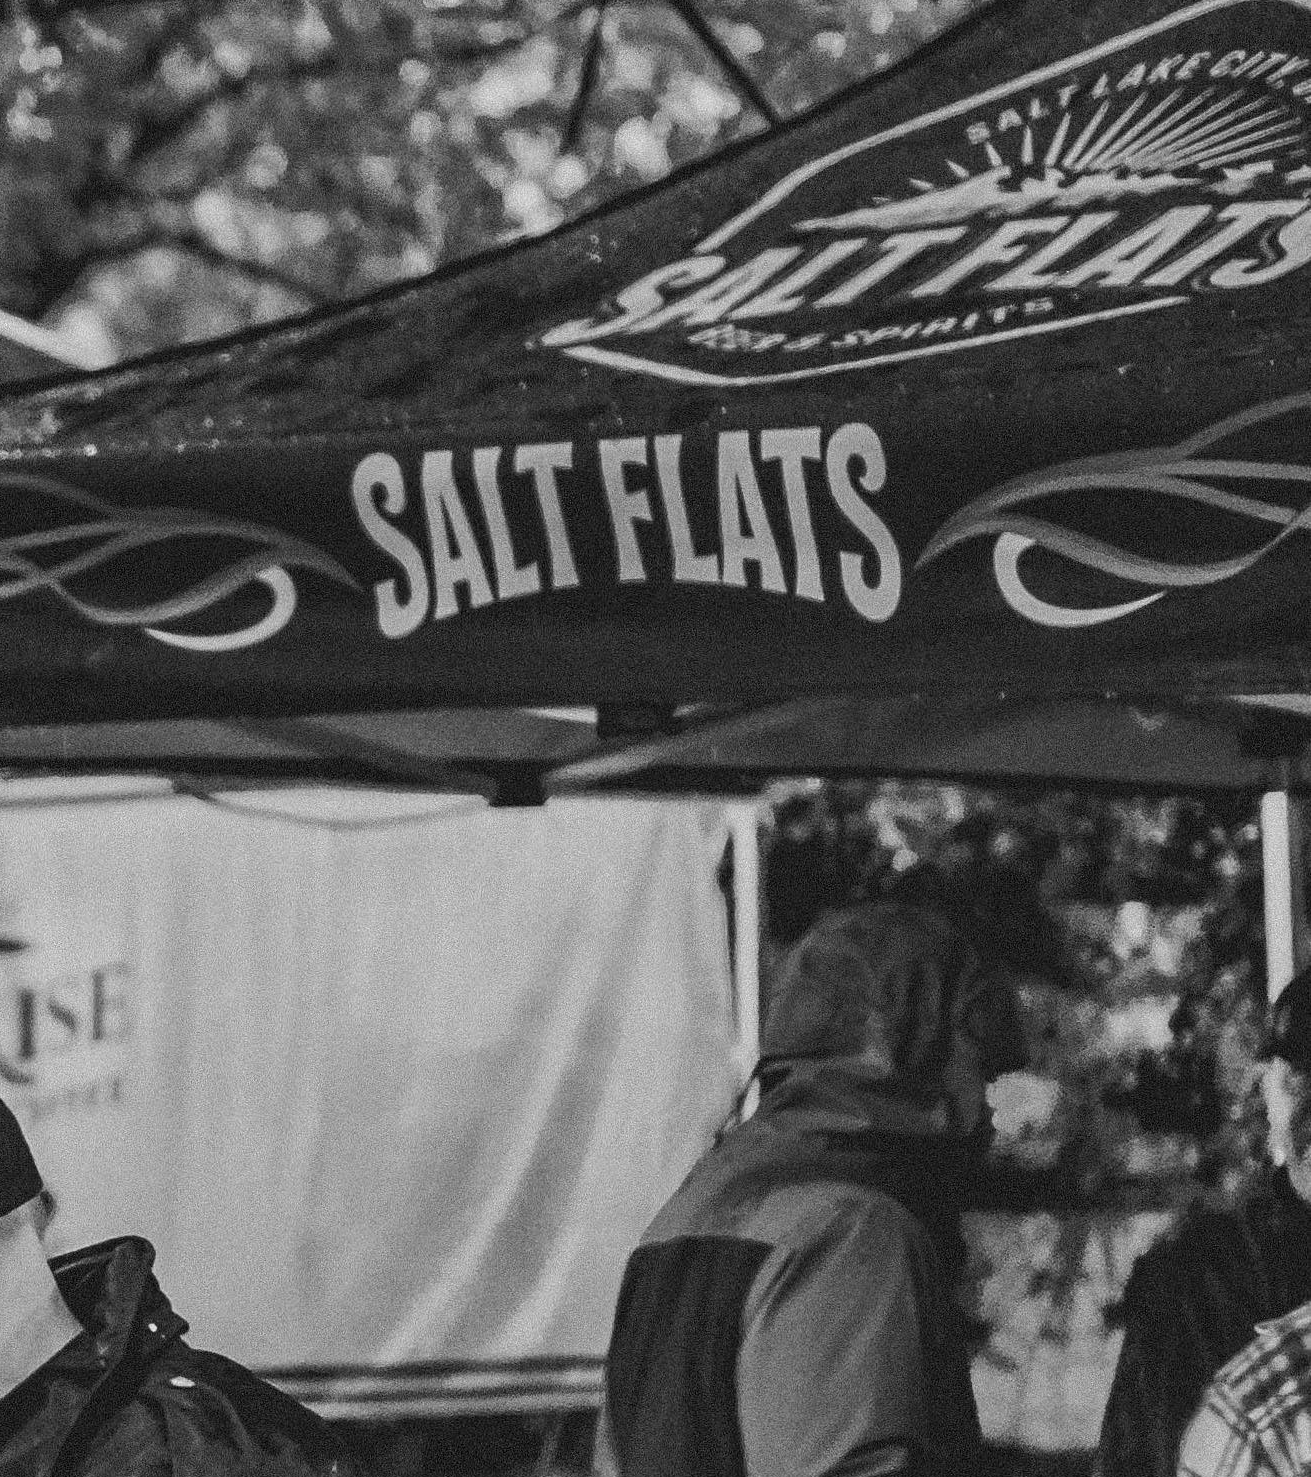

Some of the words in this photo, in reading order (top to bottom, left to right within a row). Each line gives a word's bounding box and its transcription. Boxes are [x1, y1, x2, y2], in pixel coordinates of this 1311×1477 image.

[966, 84, 1078, 144] SALT
[1091, 51, 1211, 100] LAKE
[539, 225, 967, 349] SALT
[909, 199, 1311, 298] FLATS
[352, 452, 580, 640] SALT
[598, 422, 902, 624] FLATS
